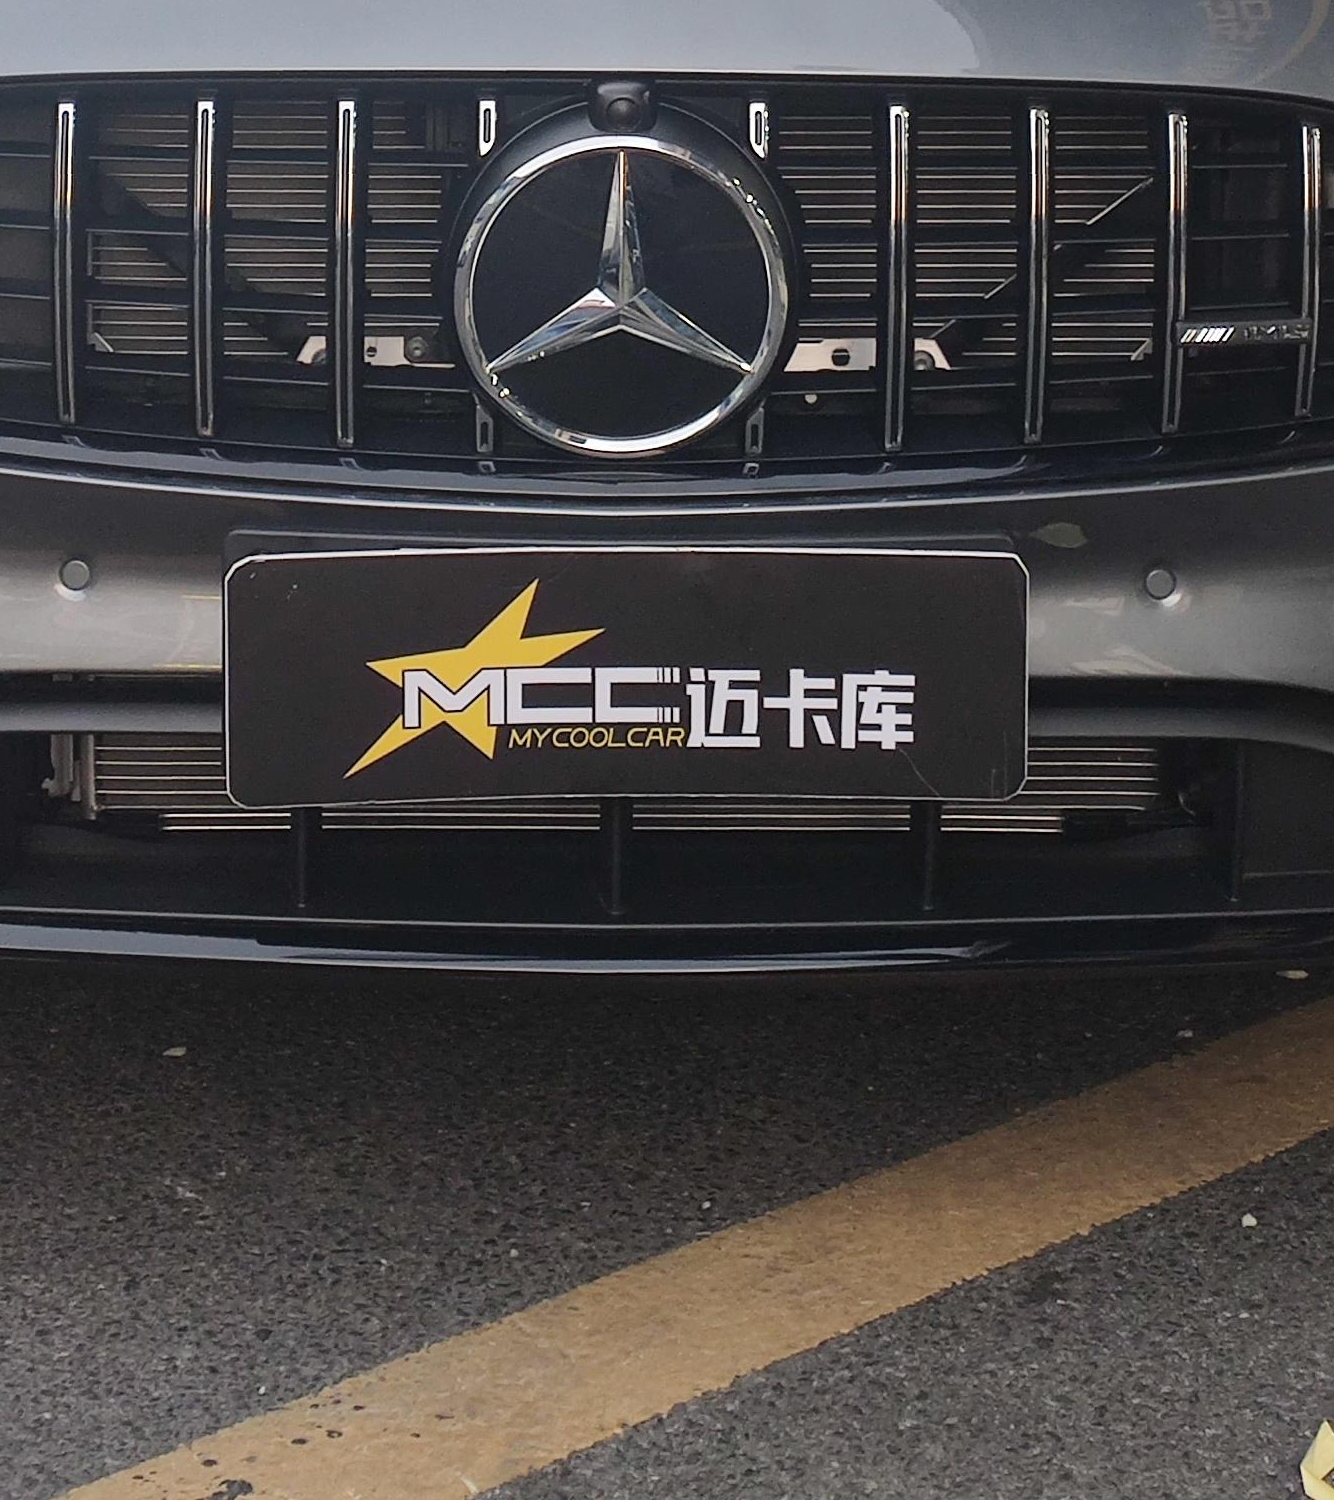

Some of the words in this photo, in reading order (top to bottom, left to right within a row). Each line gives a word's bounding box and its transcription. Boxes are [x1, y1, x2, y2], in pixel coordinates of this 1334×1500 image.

[403, 666, 680, 728] MCC
[685, 667, 917, 750] 迈卡库
[508, 726, 685, 748] MYCOOLCAR
